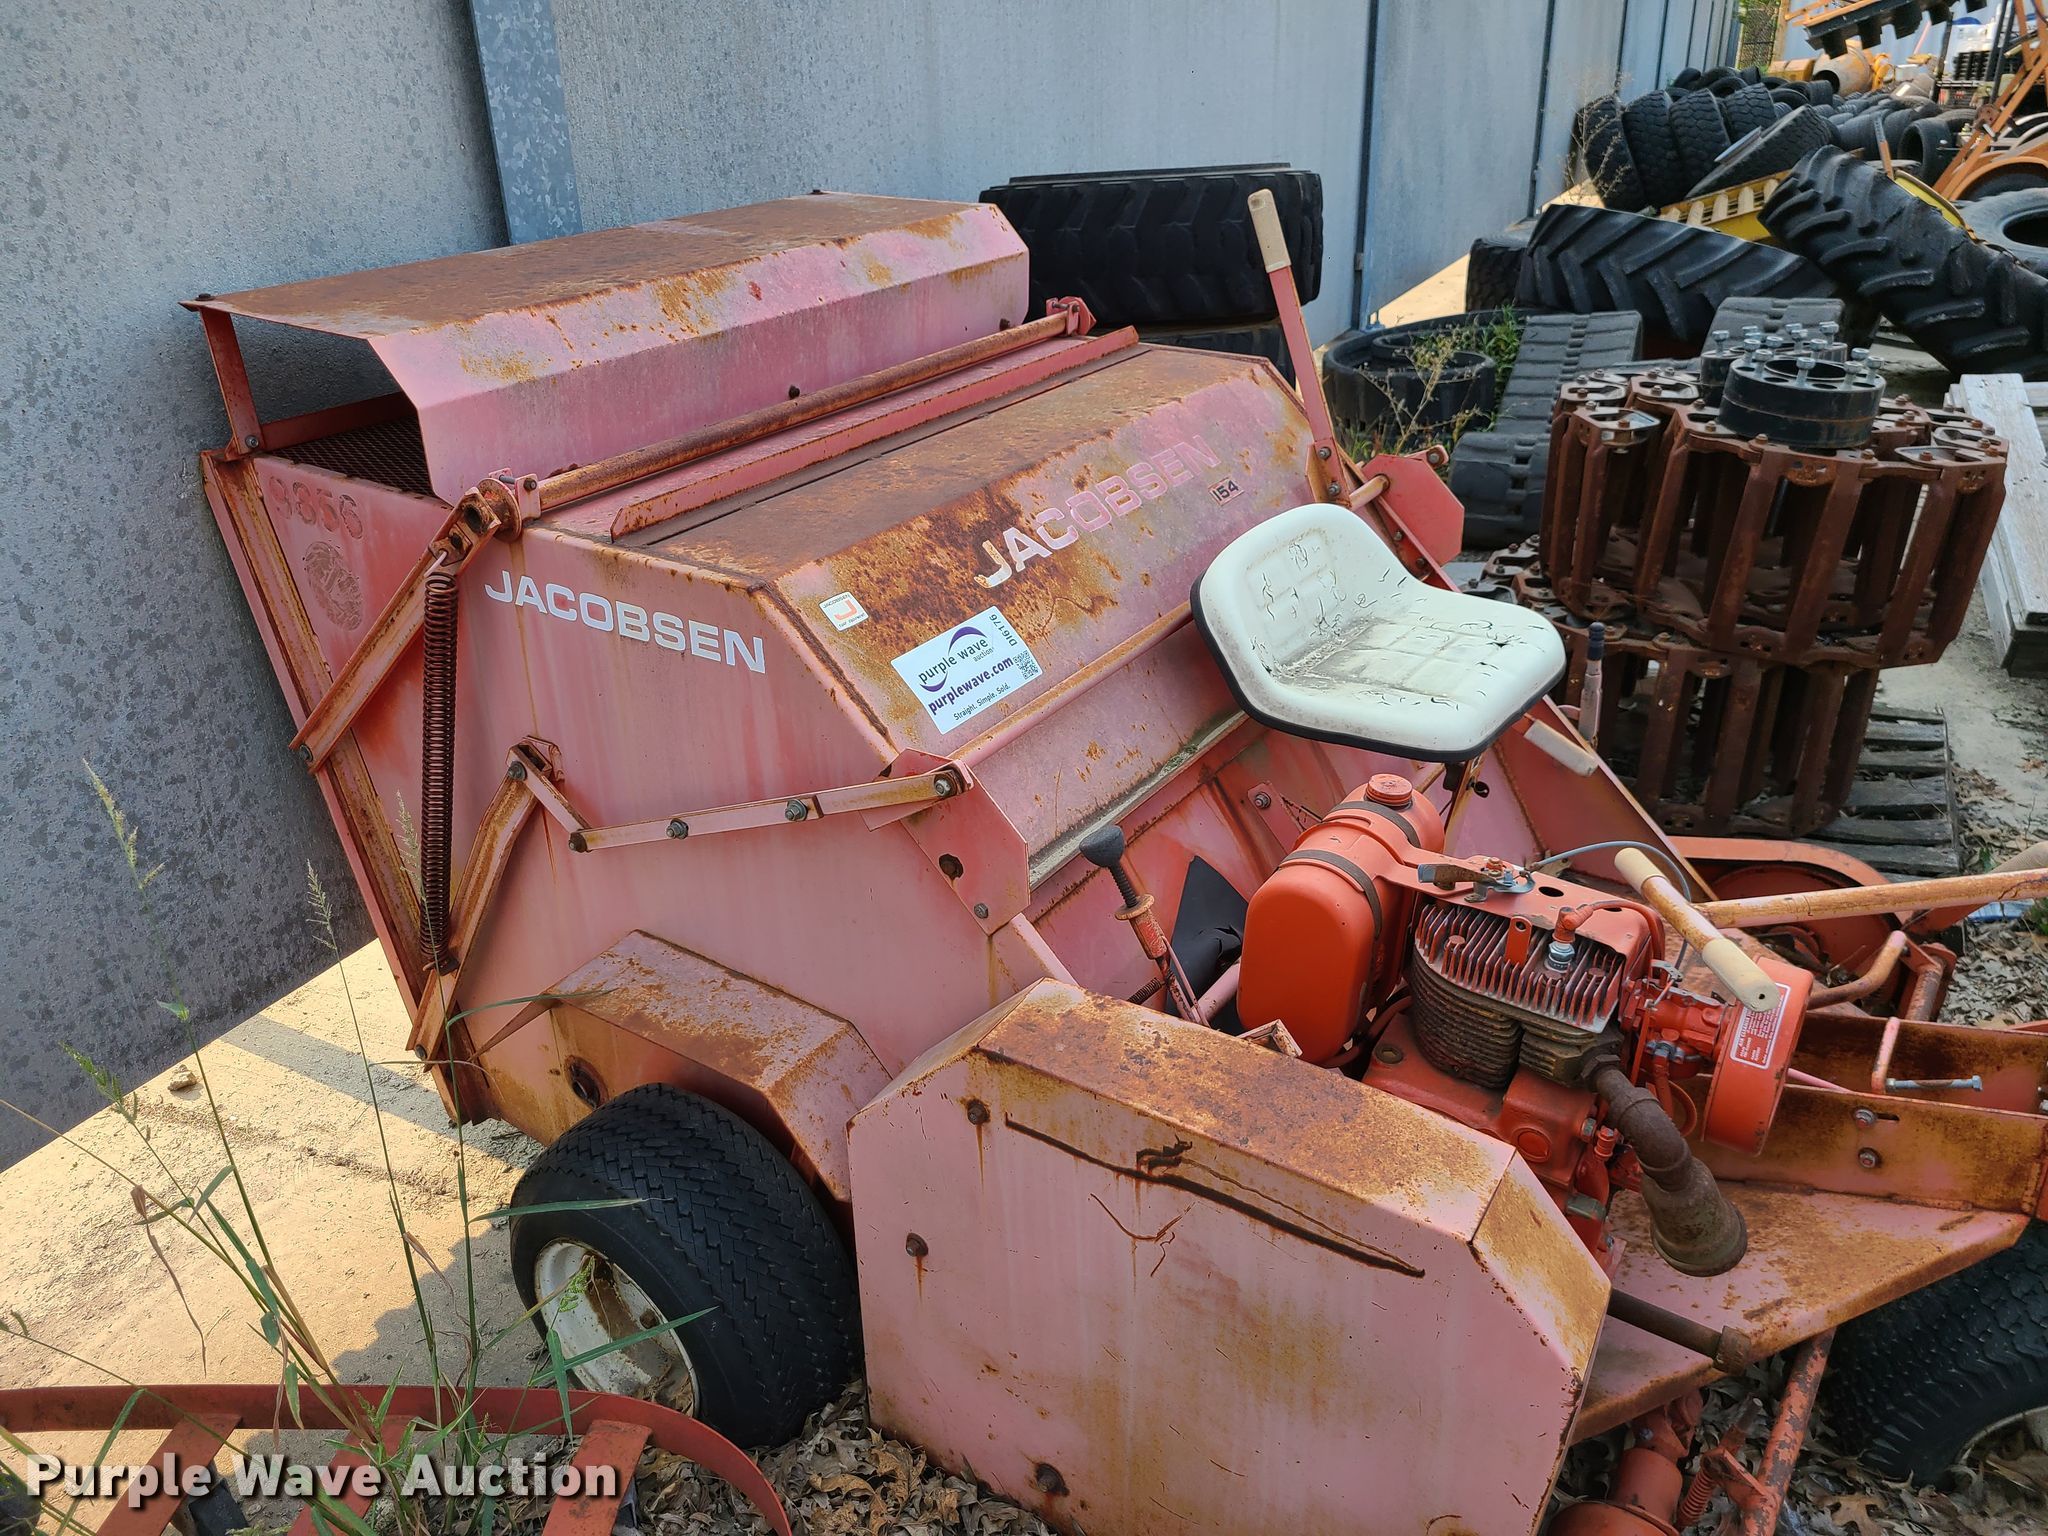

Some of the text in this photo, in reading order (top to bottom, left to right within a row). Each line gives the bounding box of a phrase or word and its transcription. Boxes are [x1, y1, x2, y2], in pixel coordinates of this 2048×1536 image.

[974, 434, 1222, 589] JACOBSEN
[1212, 480, 1239, 501] 154
[484, 570, 766, 674] JACOBSEN
[918, 638, 989, 684] purple wave
[928, 656, 1014, 715] purplewave.com
[953, 682, 1011, 721] Straight. Simple. Sold.
